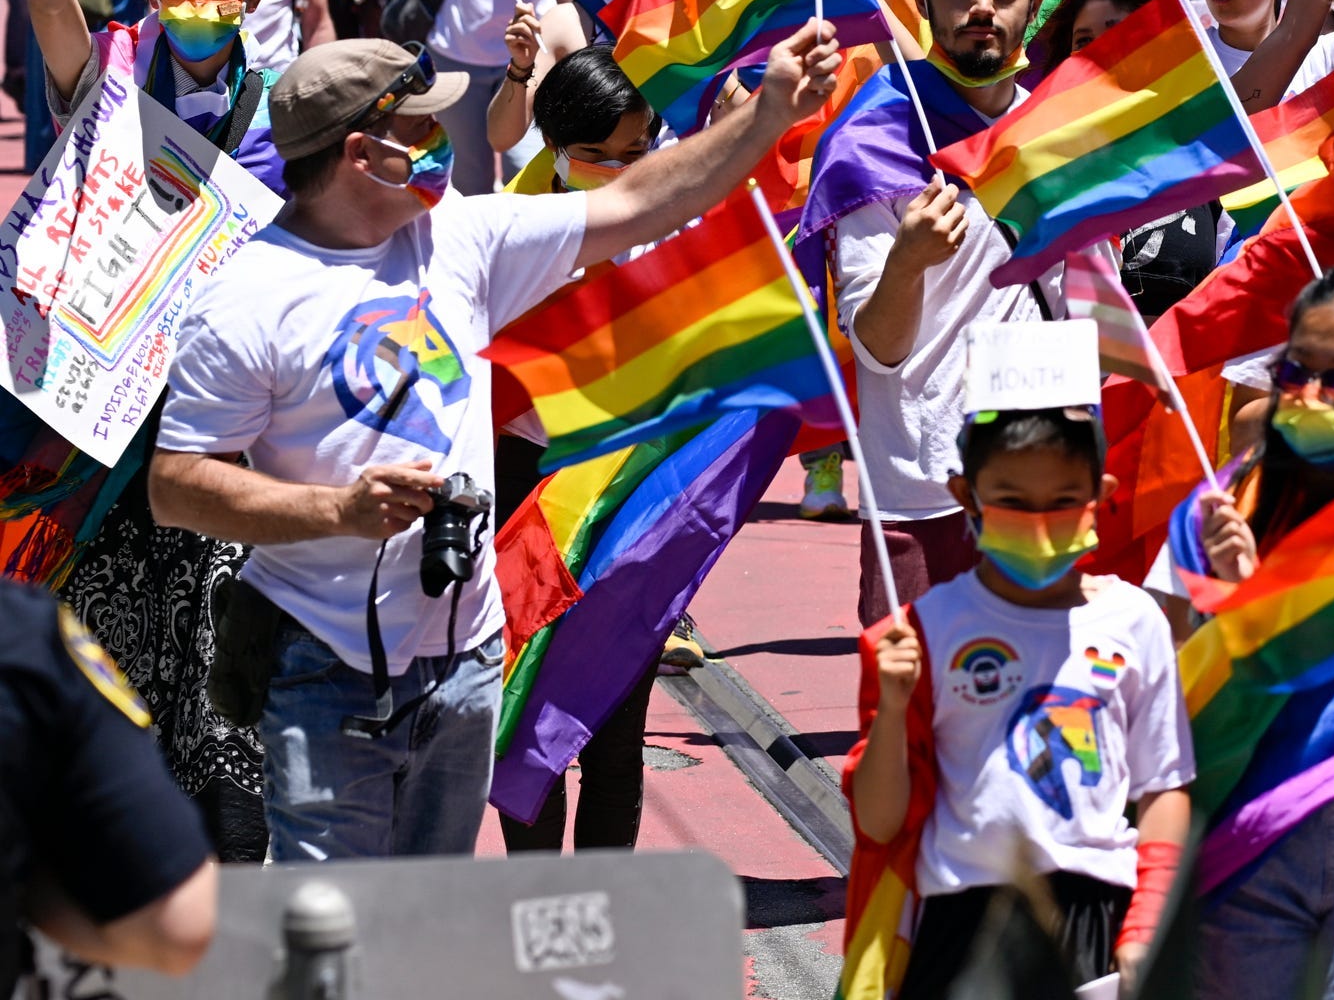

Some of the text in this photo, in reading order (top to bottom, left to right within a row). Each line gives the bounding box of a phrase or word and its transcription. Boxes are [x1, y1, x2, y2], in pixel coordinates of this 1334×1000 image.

[9, 167, 66, 239] HAS
[64, 74, 128, 182] SHOWN
[11, 148, 119, 306] ALL RIGHTS
[196, 203, 249, 275] HUMAN
[34, 268, 73, 320] ARE
[70, 235, 92, 264] AT
[157, 299, 183, 337] BILL
[184, 277, 193, 299] OF
[55, 353, 88, 409] CIVIL
[989, 365, 1066, 393] MONTH
